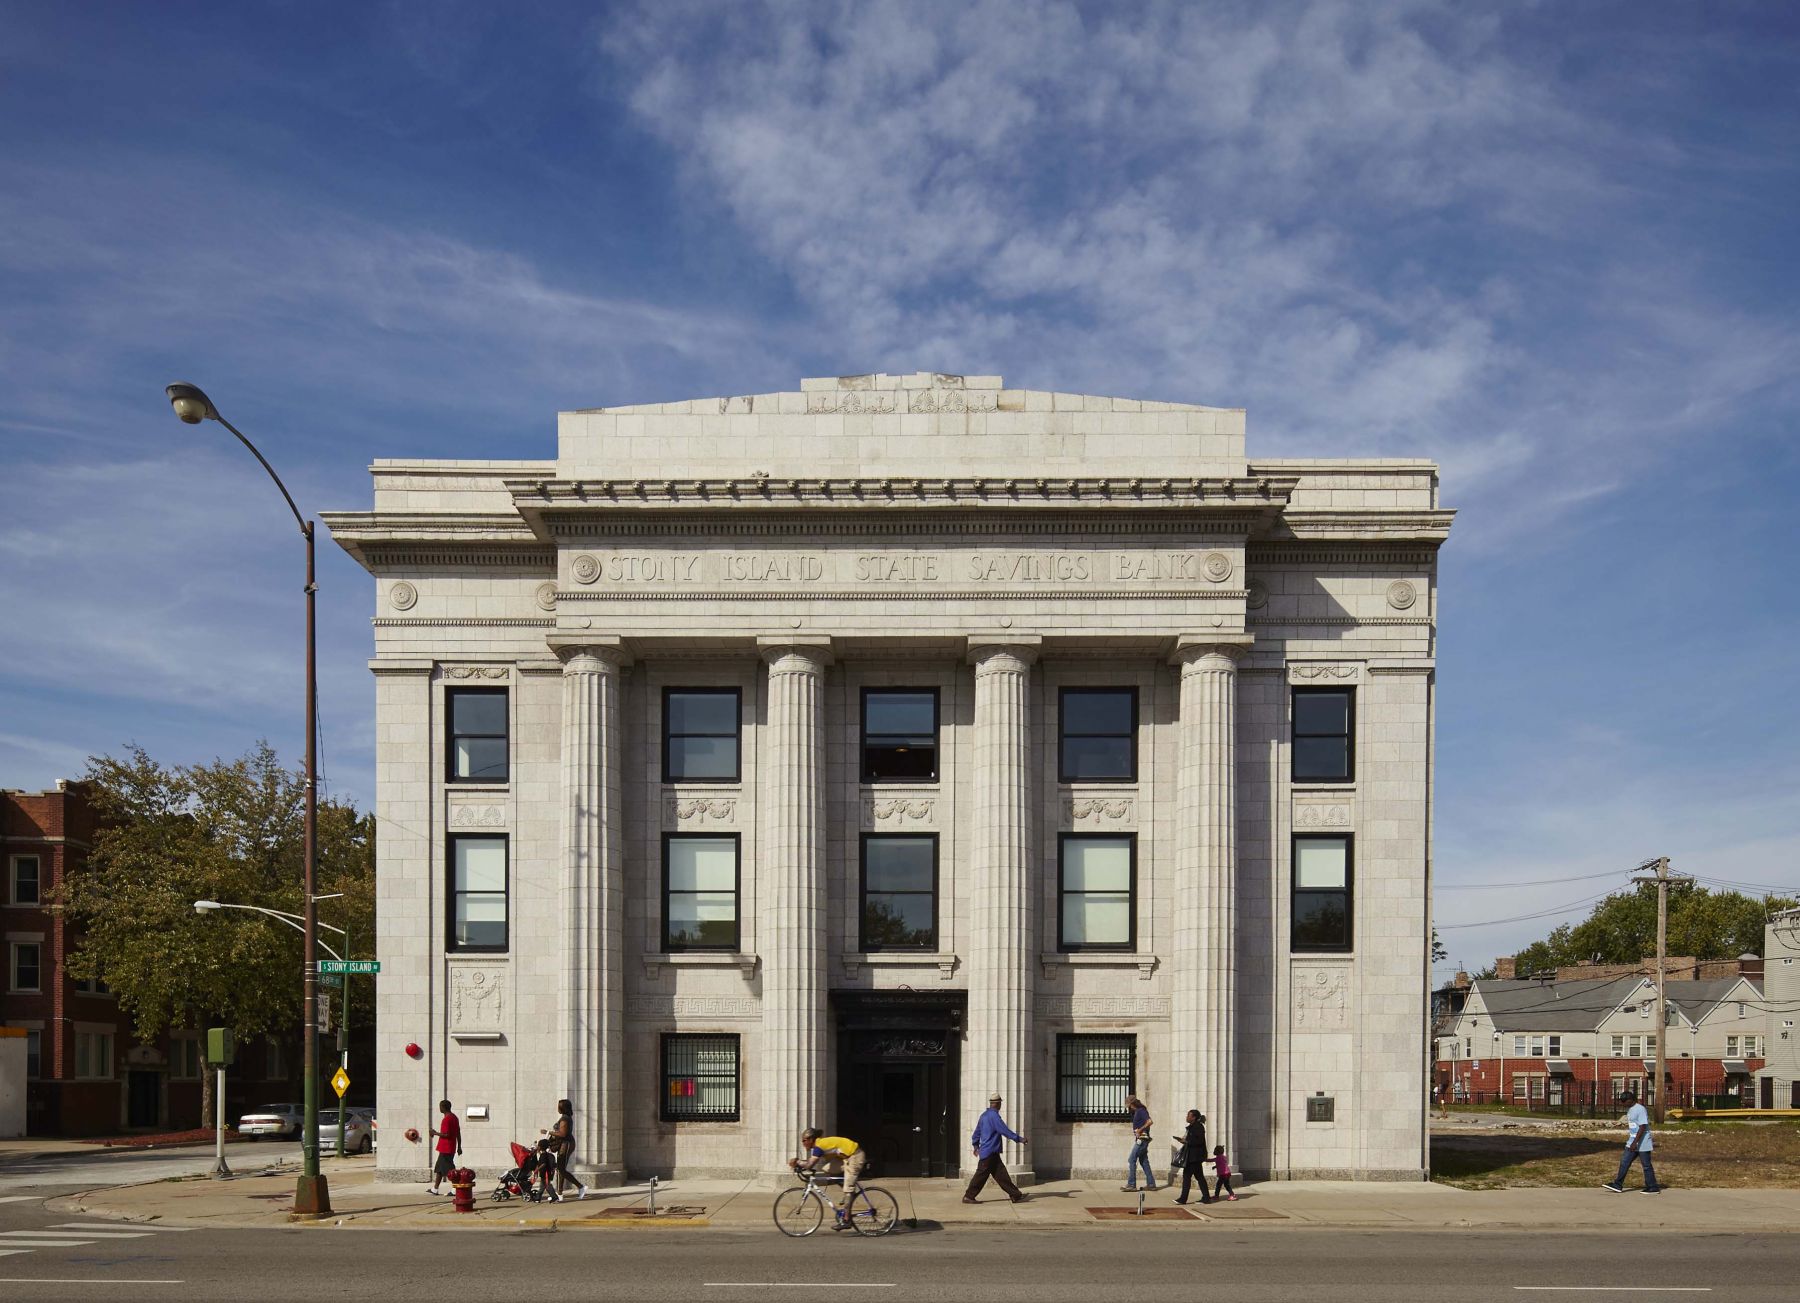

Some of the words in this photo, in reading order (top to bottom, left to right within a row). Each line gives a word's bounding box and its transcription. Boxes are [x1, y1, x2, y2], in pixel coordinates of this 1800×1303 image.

[607, 556, 699, 581] STONY
[723, 556, 823, 581] ISLAND
[855, 556, 939, 581] STATE
[968, 555, 1089, 581] SAVINGS
[1115, 554, 1196, 580] BANK
[327, 962, 347, 971] STONY
[349, 962, 372, 971] ISLAND
